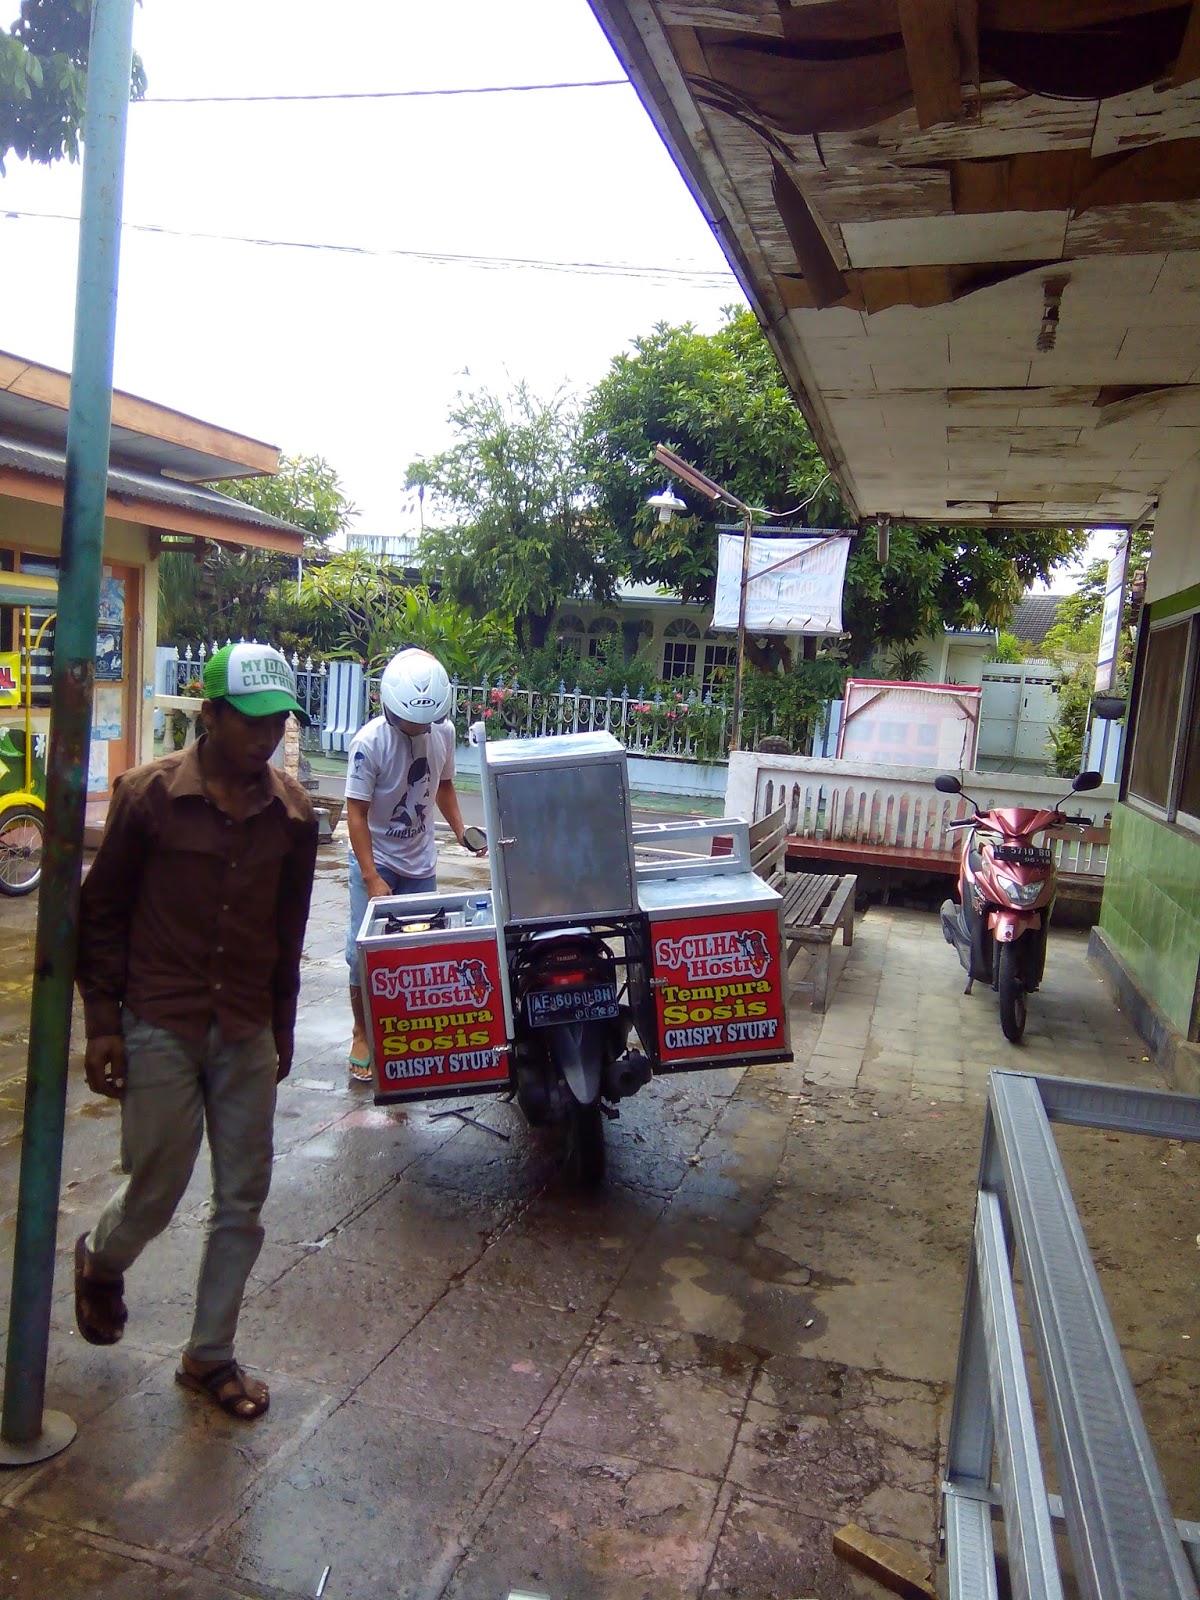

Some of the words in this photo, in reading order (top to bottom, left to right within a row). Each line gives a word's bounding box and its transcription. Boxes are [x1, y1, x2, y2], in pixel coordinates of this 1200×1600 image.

[241, 659, 261, 673] MY
[1011, 847, 1034, 856] 5710
[661, 980, 771, 1003] Tempura
[379, 1009, 493, 1033] Tempura
[663, 999, 767, 1025] Sosis
[382, 1028, 490, 1056] Sosis
[665, 1025, 723, 1049] CRISPY
[727, 1019, 778, 1045] STUFF
[385, 1055, 445, 1079] CRISPY
[449, 1049, 500, 1072] STUFF
